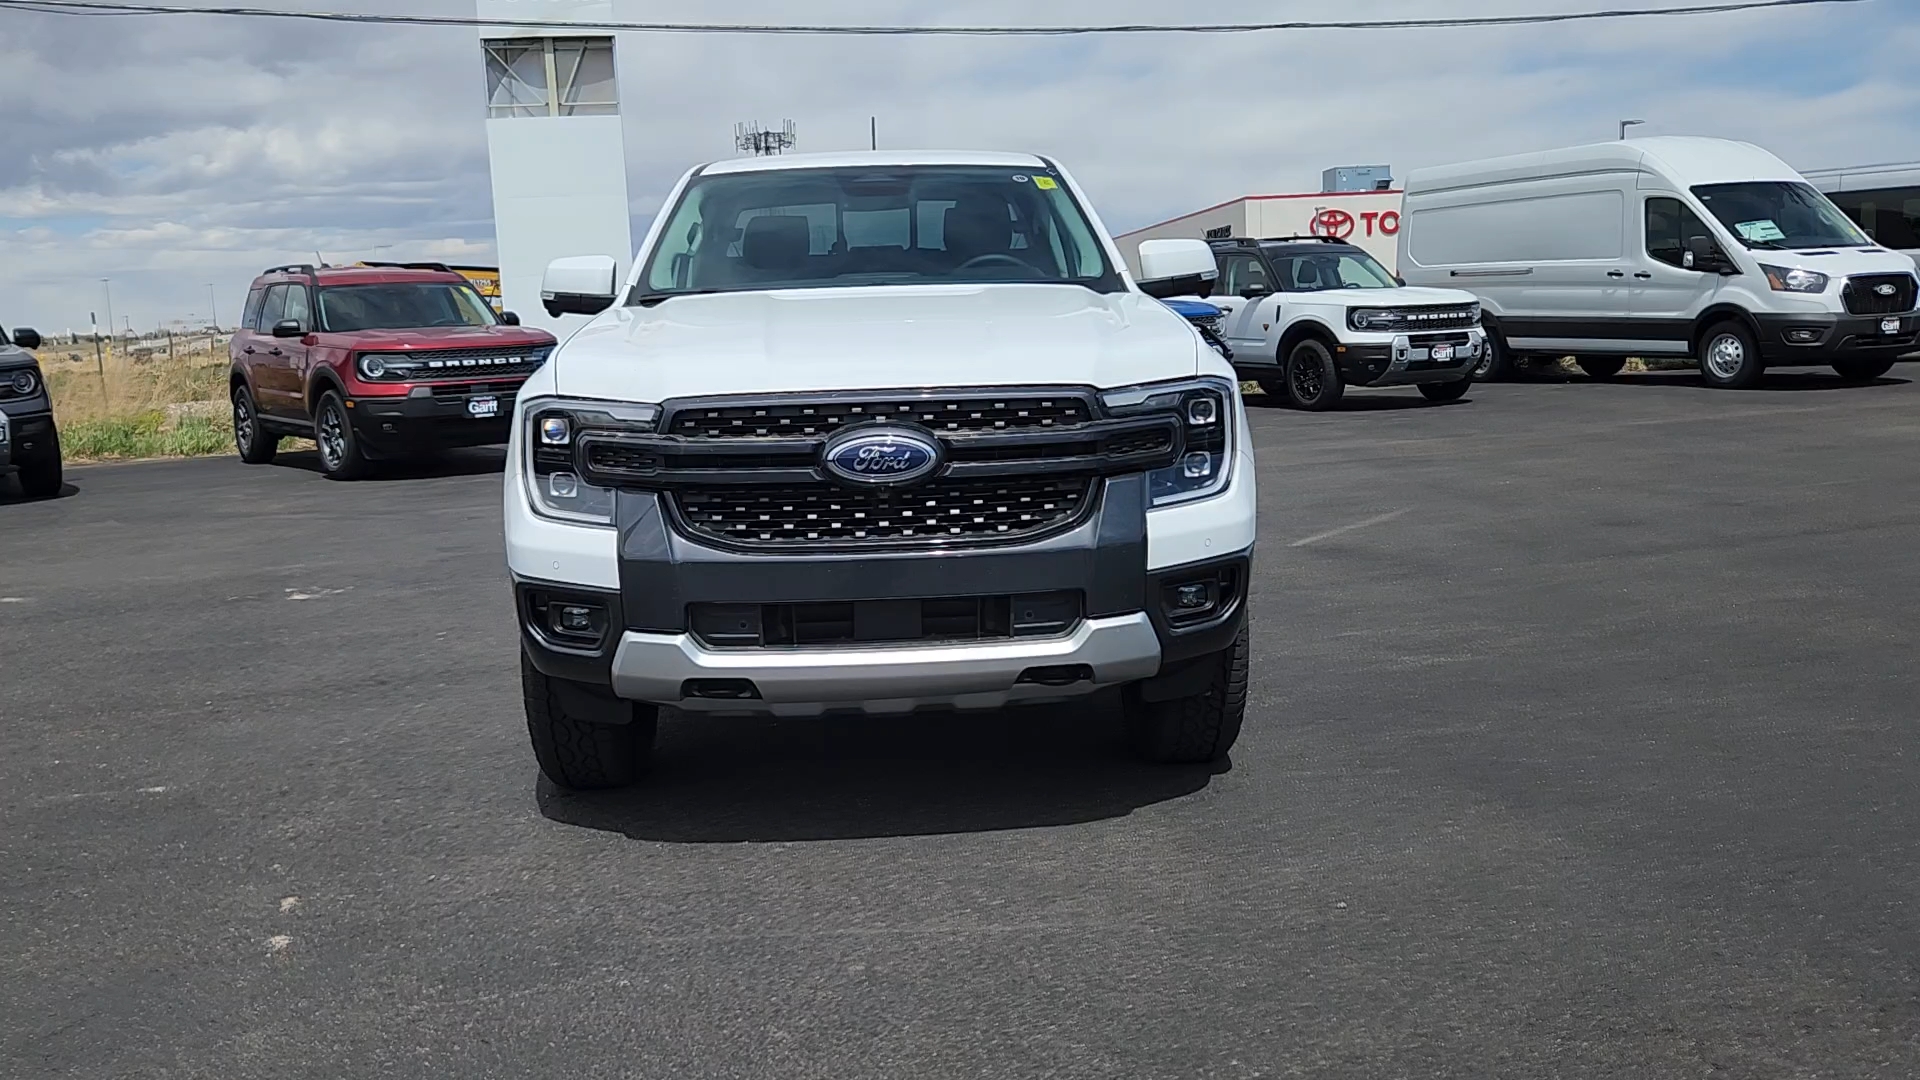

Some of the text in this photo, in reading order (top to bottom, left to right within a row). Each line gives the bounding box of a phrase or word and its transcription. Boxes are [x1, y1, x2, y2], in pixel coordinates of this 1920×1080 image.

[1431, 346, 1454, 359] Garff
[428, 357, 522, 368] BRONCO
[468, 400, 499, 414] Garff
[853, 445, 910, 471] Ford
